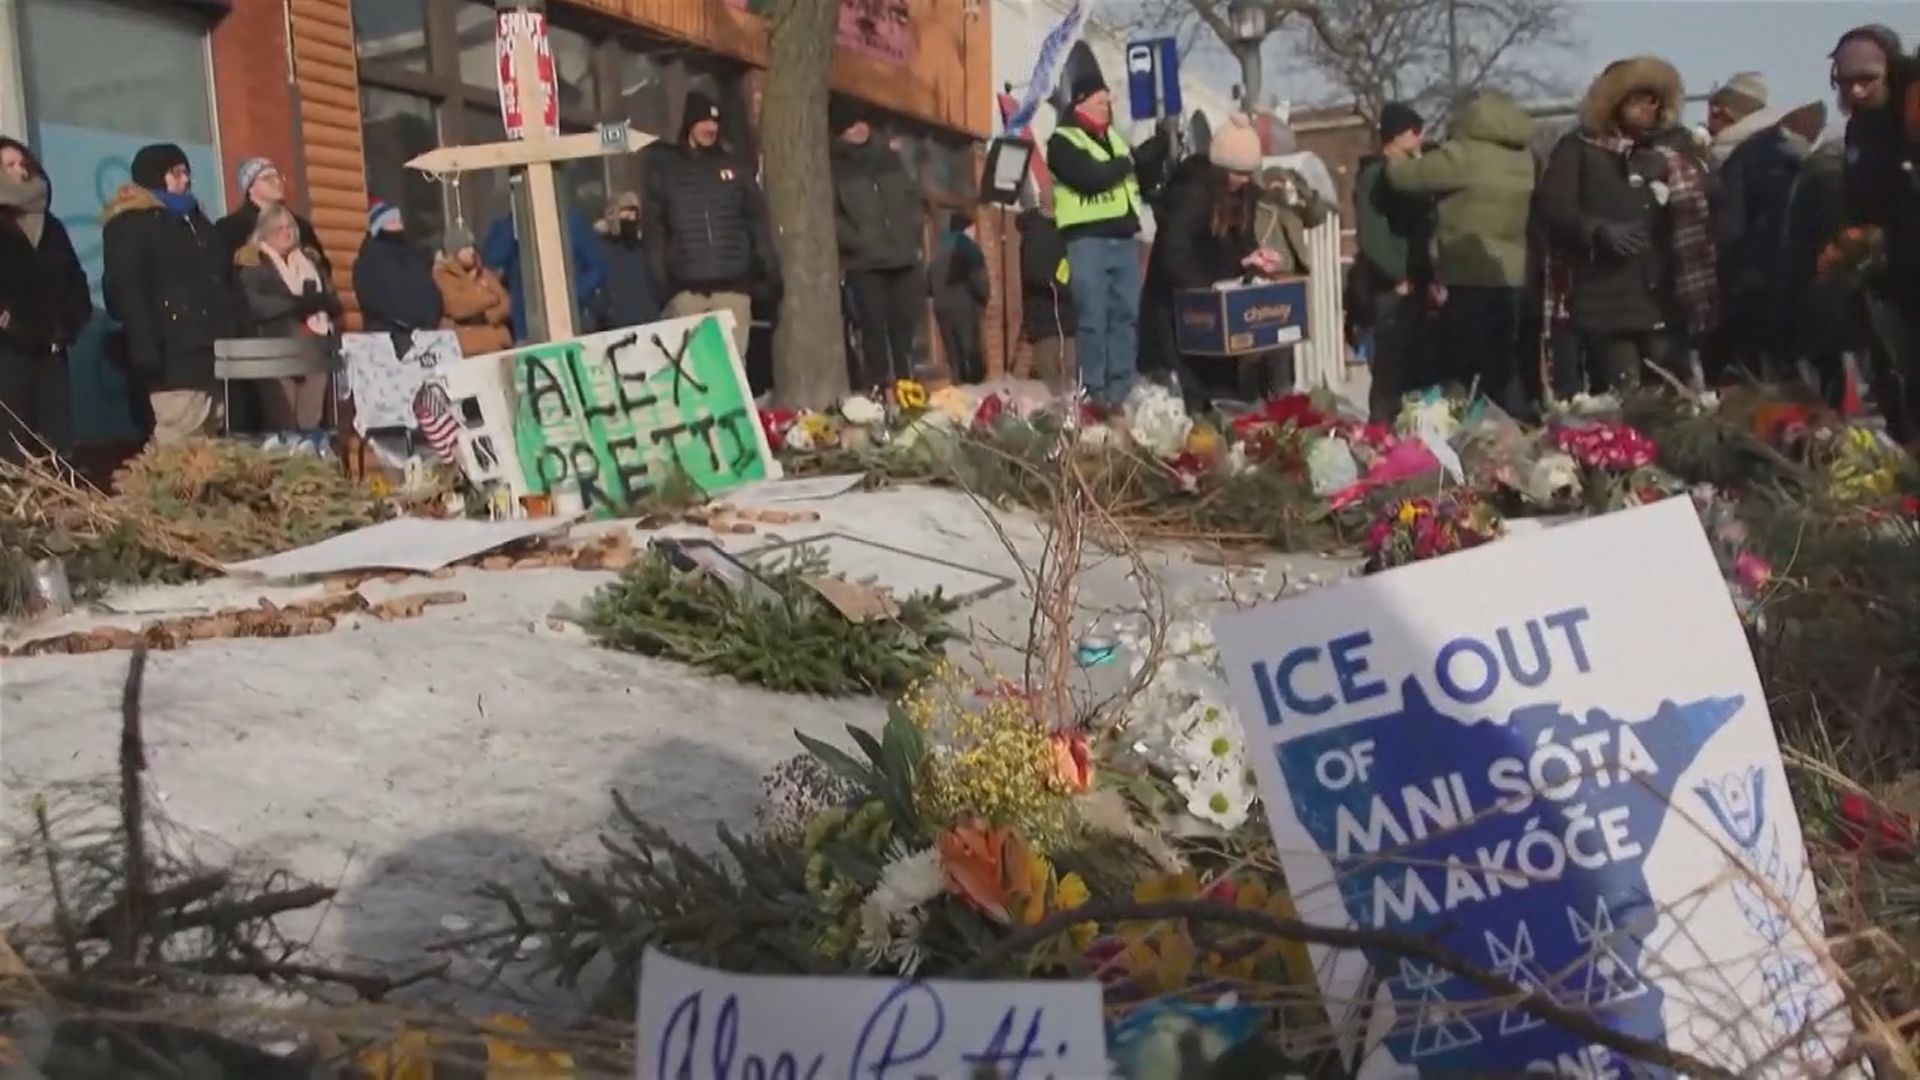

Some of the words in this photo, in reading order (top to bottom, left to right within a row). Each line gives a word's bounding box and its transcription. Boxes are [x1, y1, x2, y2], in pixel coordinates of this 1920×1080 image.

[525, 328, 709, 427] ALEX
[536, 407, 757, 512] PRETTI
[1251, 629, 1388, 726] ICE
[1435, 607, 1591, 704] OUT
[1315, 739, 1376, 790] OF
[1336, 772, 1478, 862] MNI
[1488, 725, 1660, 814] SÓTA
[1372, 803, 1643, 930] MAKÓČE
